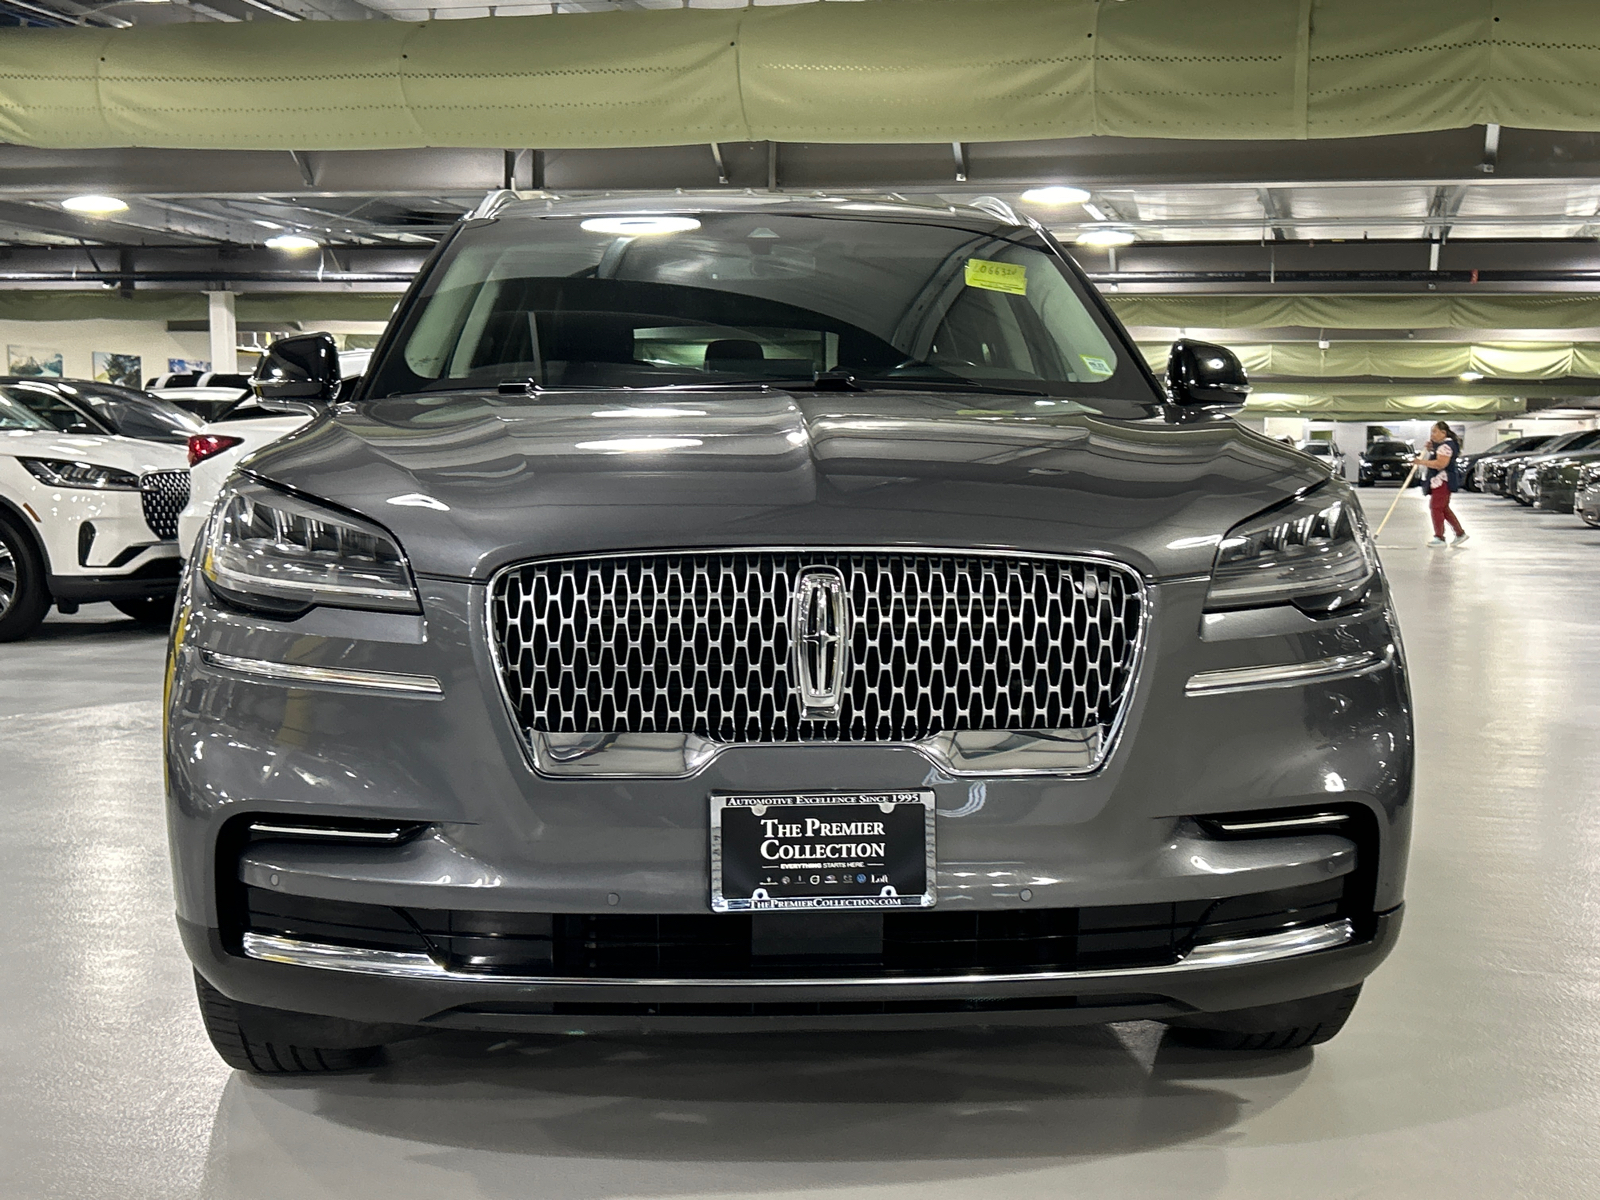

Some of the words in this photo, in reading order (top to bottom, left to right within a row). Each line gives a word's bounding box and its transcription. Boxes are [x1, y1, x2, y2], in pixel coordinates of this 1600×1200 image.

[728, 796, 793, 806] AUTOMOTIVE
[796, 795, 857, 804] EXCELLENCE
[860, 794, 888, 803] SINCE
[892, 793, 918, 802] 1995
[760, 819, 802, 837] THE
[805, 818, 885, 836] PREMIER
[760, 839, 885, 859] COLLECTION
